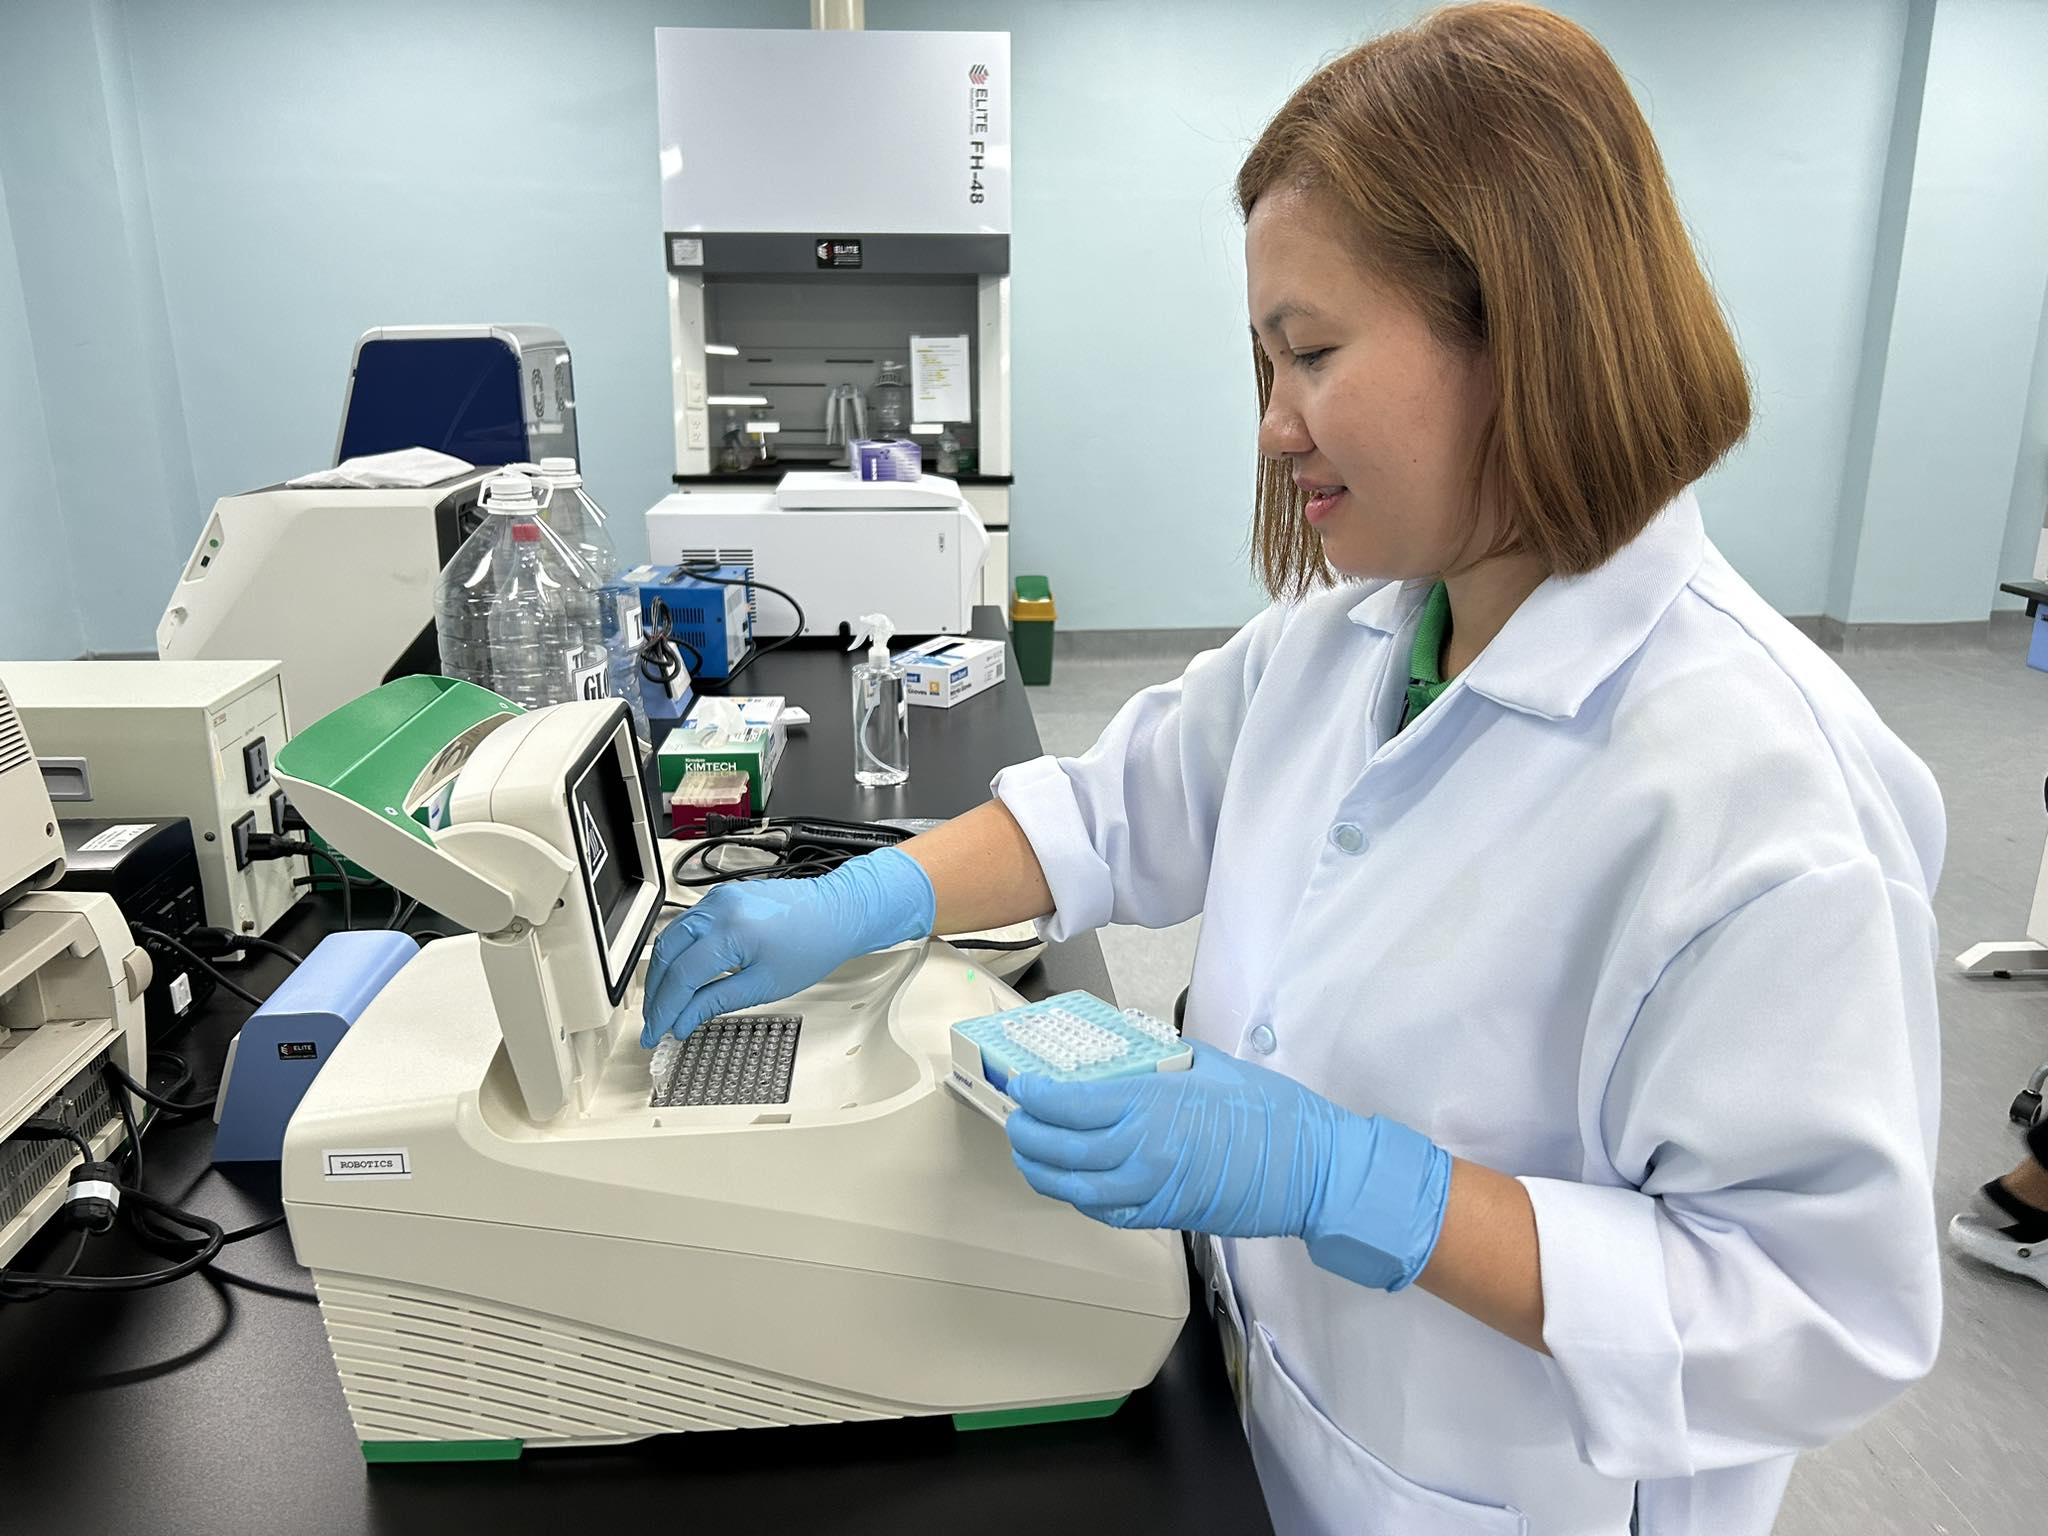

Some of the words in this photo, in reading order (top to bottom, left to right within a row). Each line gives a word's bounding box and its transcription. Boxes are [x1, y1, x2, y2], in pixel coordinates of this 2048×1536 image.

[975, 88, 988, 133] ELITE
[970, 141, 985, 204] FH-48
[833, 245, 860, 254] ELITE
[685, 762, 737, 772] KIMTECH
[340, 1160, 394, 1169] ROBOTICS
